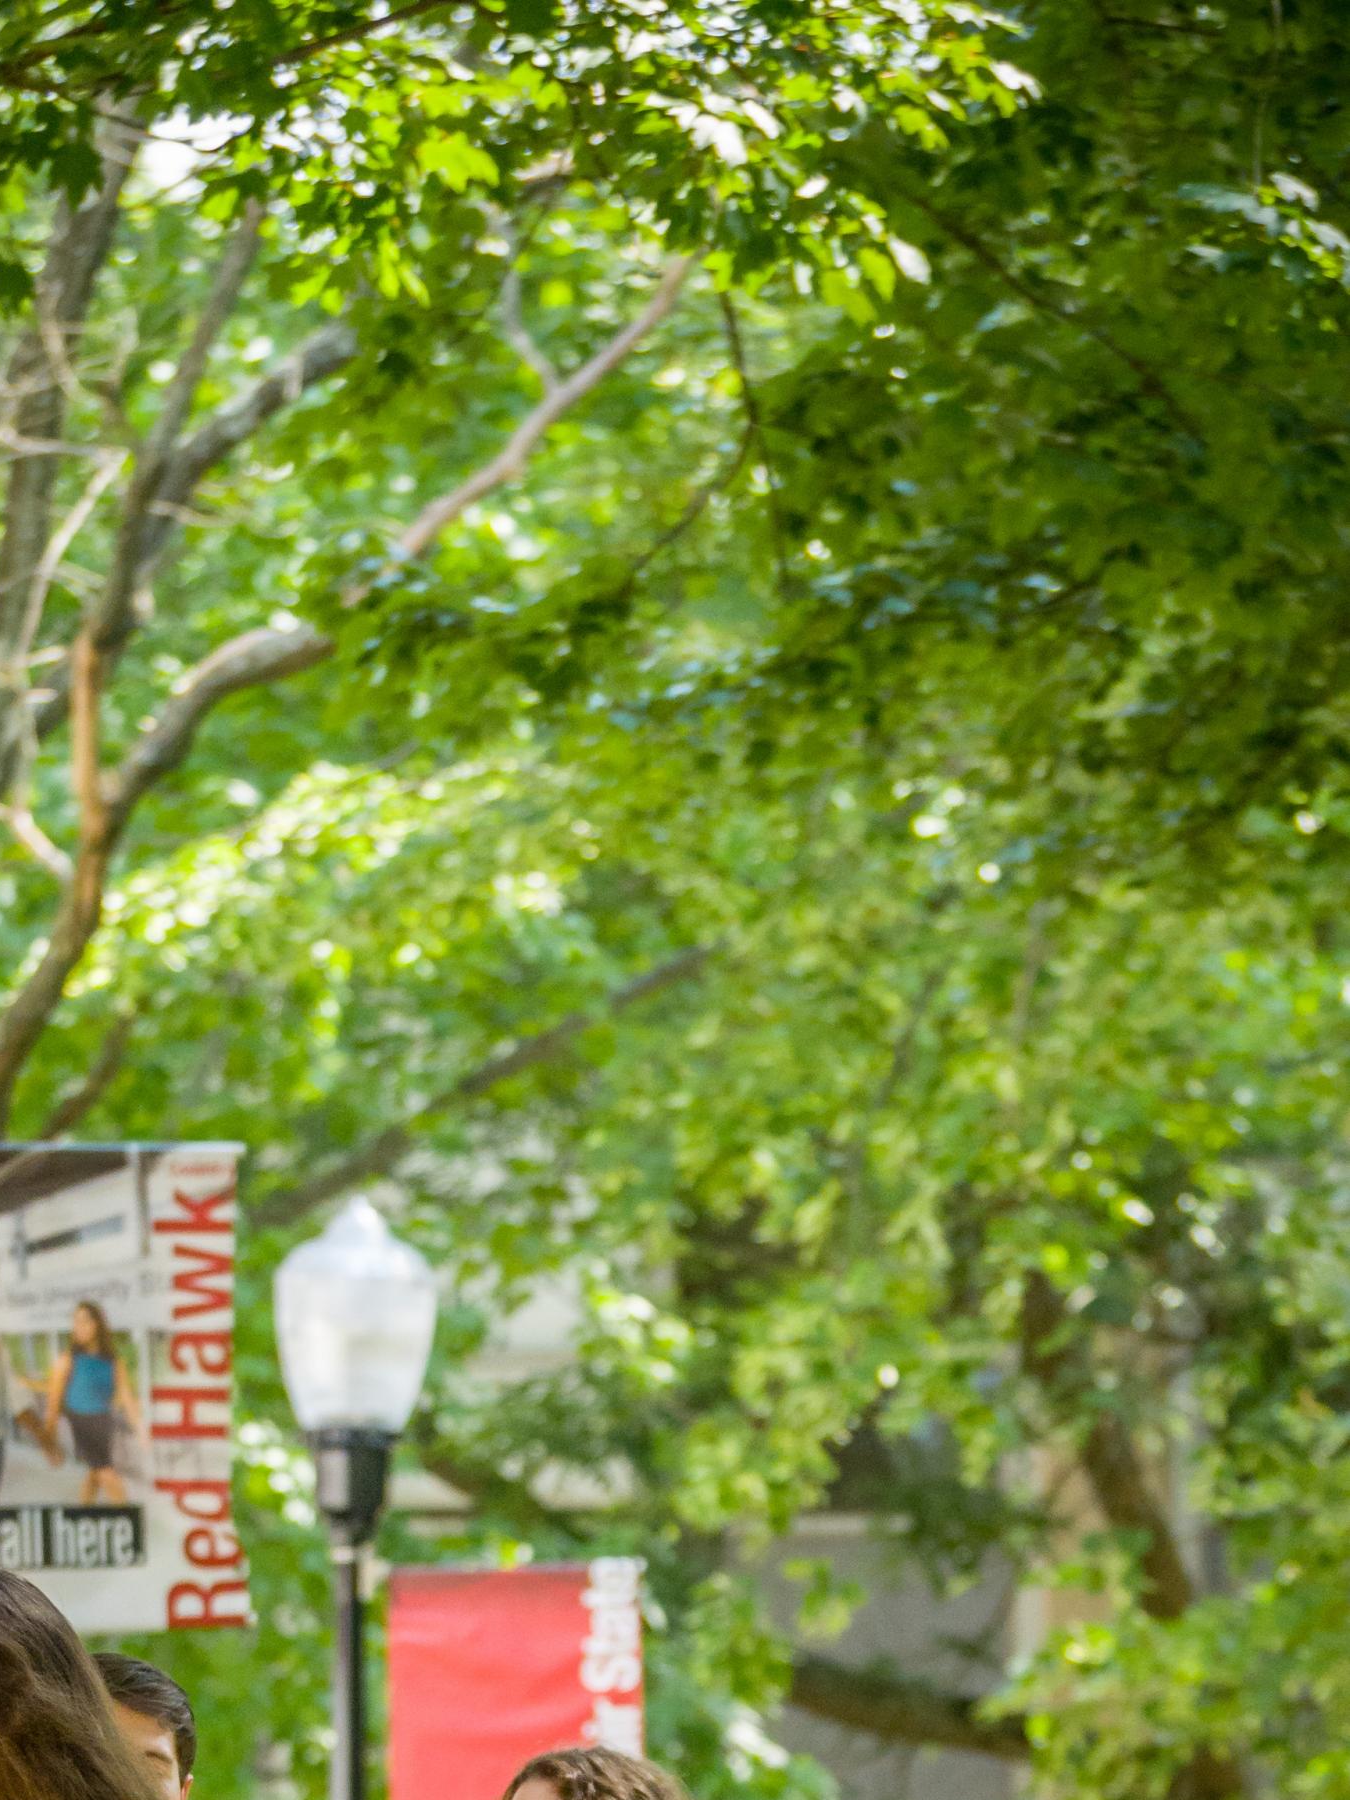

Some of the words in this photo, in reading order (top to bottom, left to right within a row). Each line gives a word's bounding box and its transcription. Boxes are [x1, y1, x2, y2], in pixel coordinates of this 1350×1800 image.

[152, 1186, 235, 1440] Hawk
[153, 1479, 249, 1630] Red
[581, 1557, 644, 1693] State
